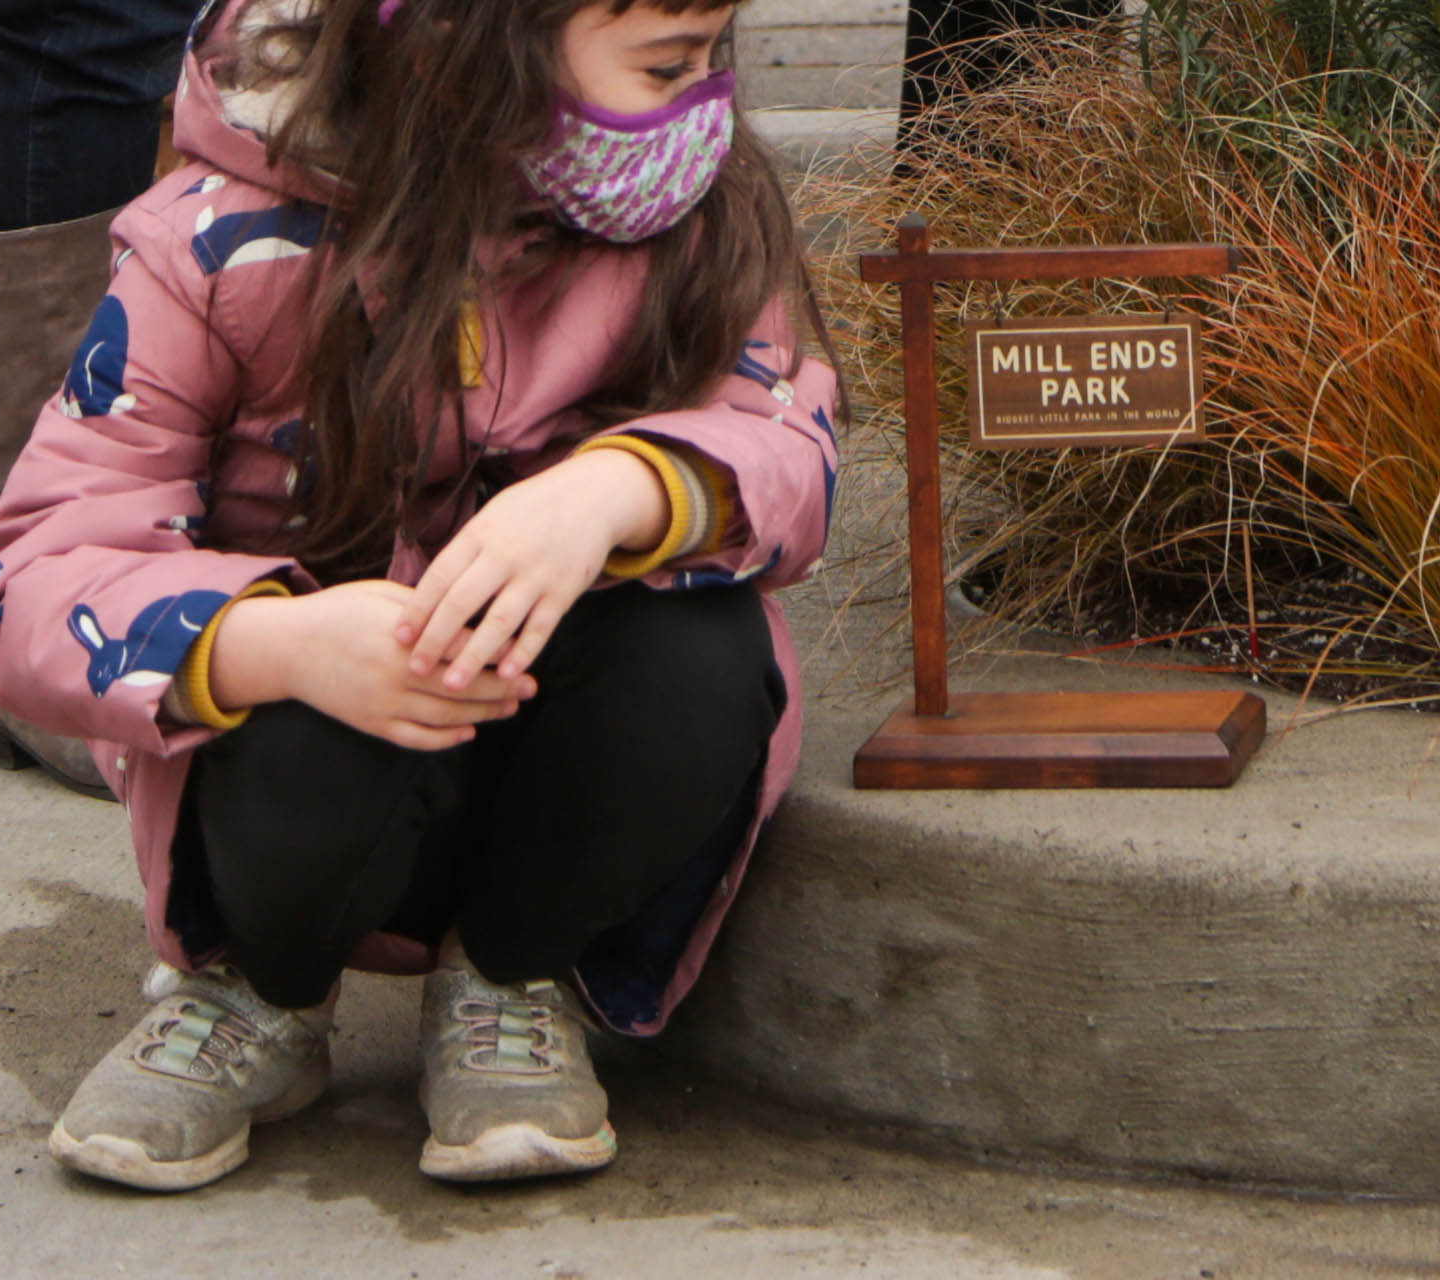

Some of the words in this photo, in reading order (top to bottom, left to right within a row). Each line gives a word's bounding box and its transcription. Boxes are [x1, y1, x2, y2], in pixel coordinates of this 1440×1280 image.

[992, 344, 1072, 373] MILL
[1090, 339, 1178, 371] ENDS
[1041, 375, 1130, 407] PARK
[1040, 413, 1070, 423] LITTLE
[1075, 412, 1101, 421] PARK
[1108, 412, 1118, 421] IN
[1124, 410, 1139, 420] THE
[1146, 408, 1180, 419] WORLD
